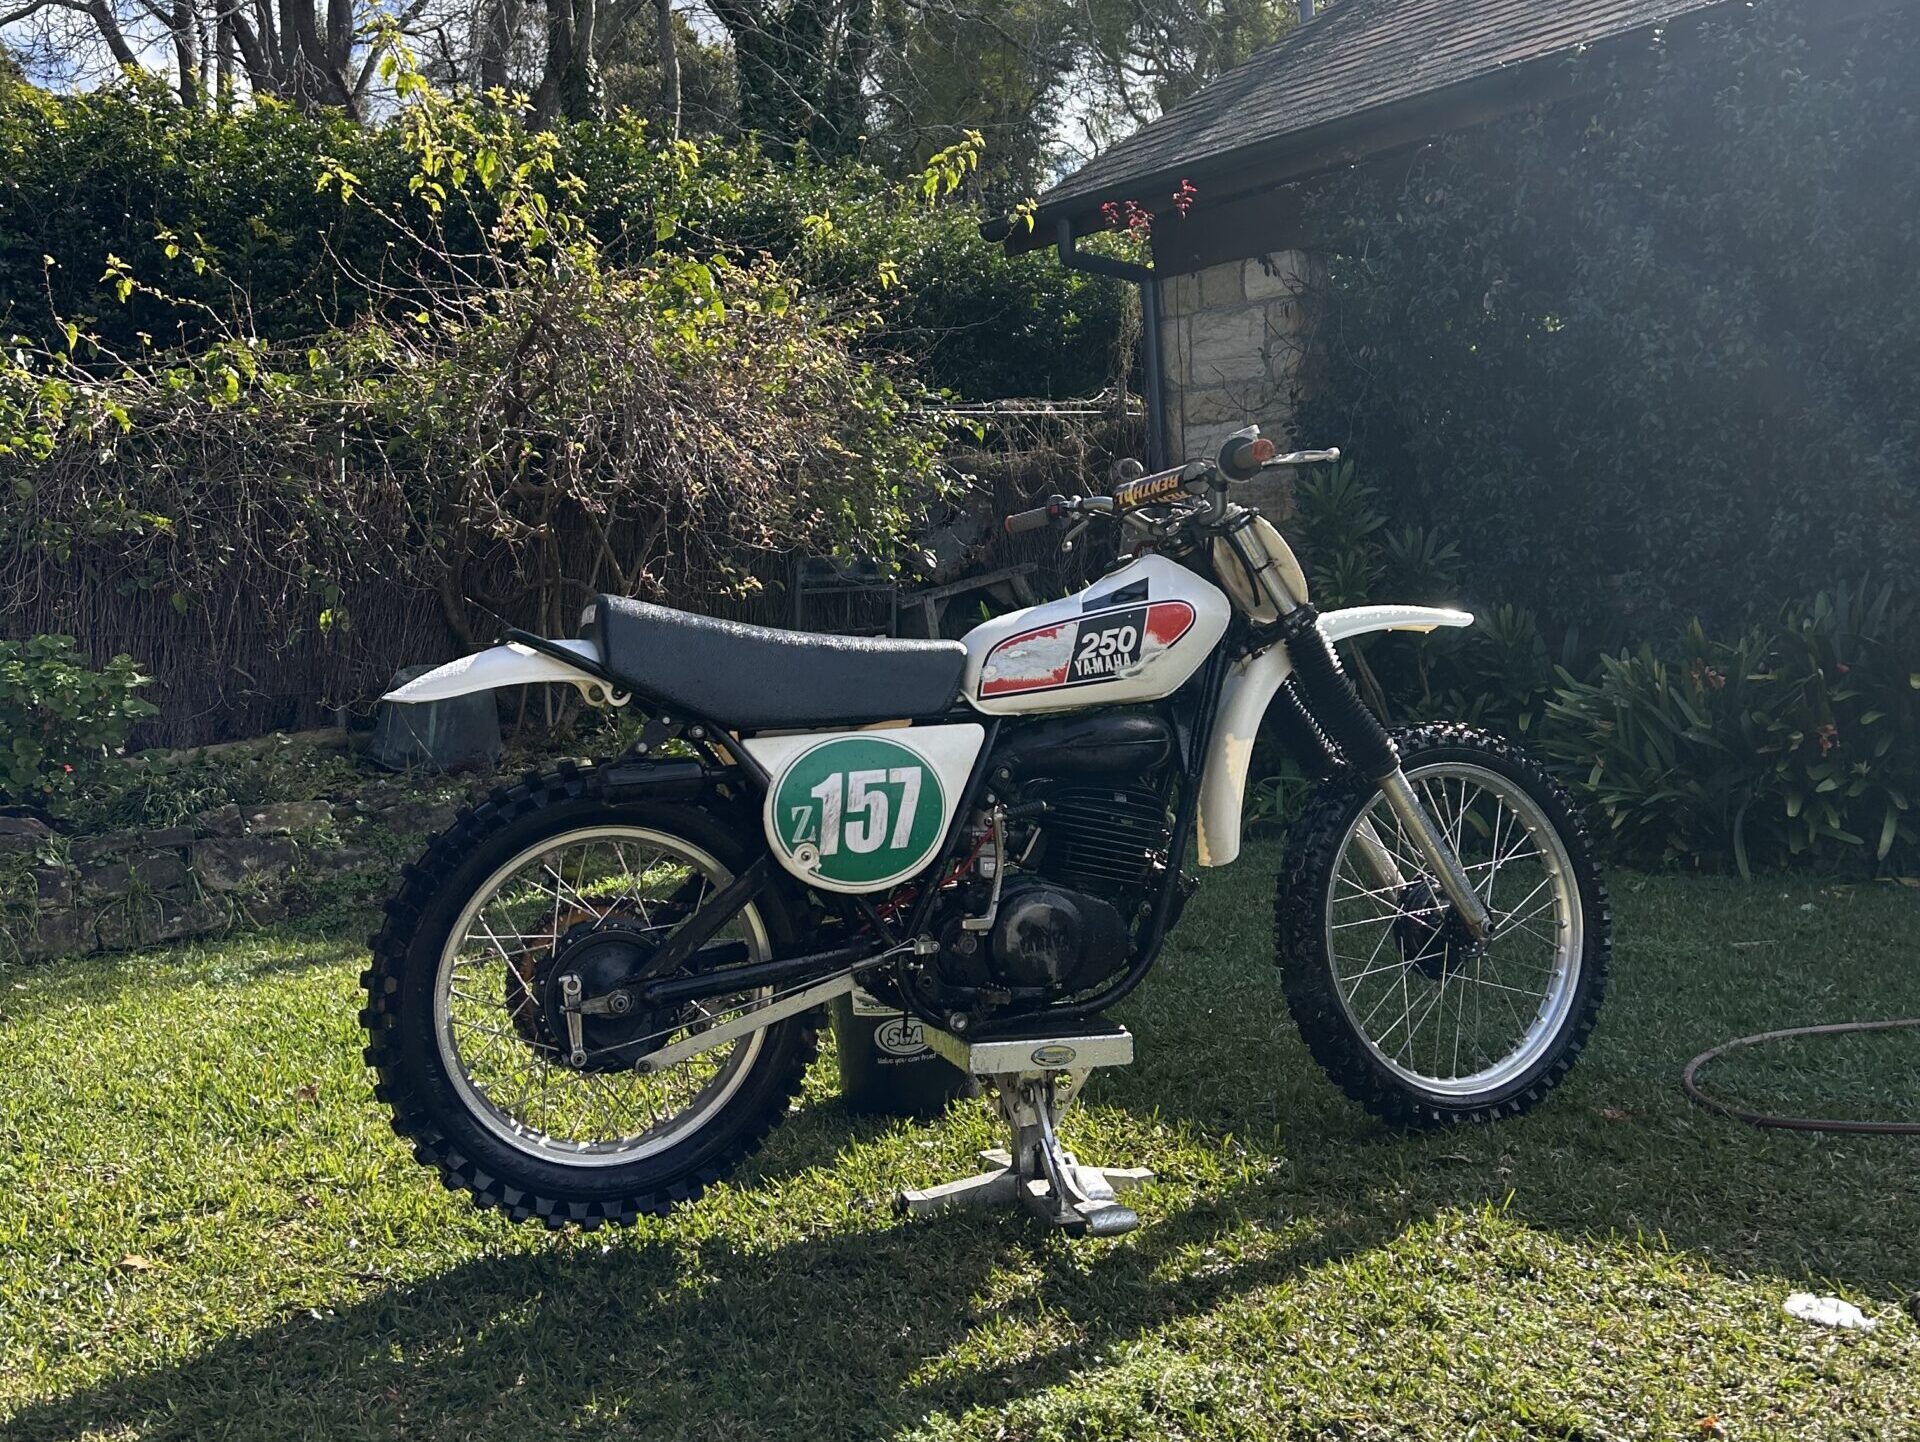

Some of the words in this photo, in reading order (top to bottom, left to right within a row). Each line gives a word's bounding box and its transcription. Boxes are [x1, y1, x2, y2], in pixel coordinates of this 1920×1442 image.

[1116, 474, 1179, 505] RENTHAL
[1079, 626, 1137, 659] 250
[1074, 653, 1132, 676] YAMAHA
[811, 766, 922, 856] 157
